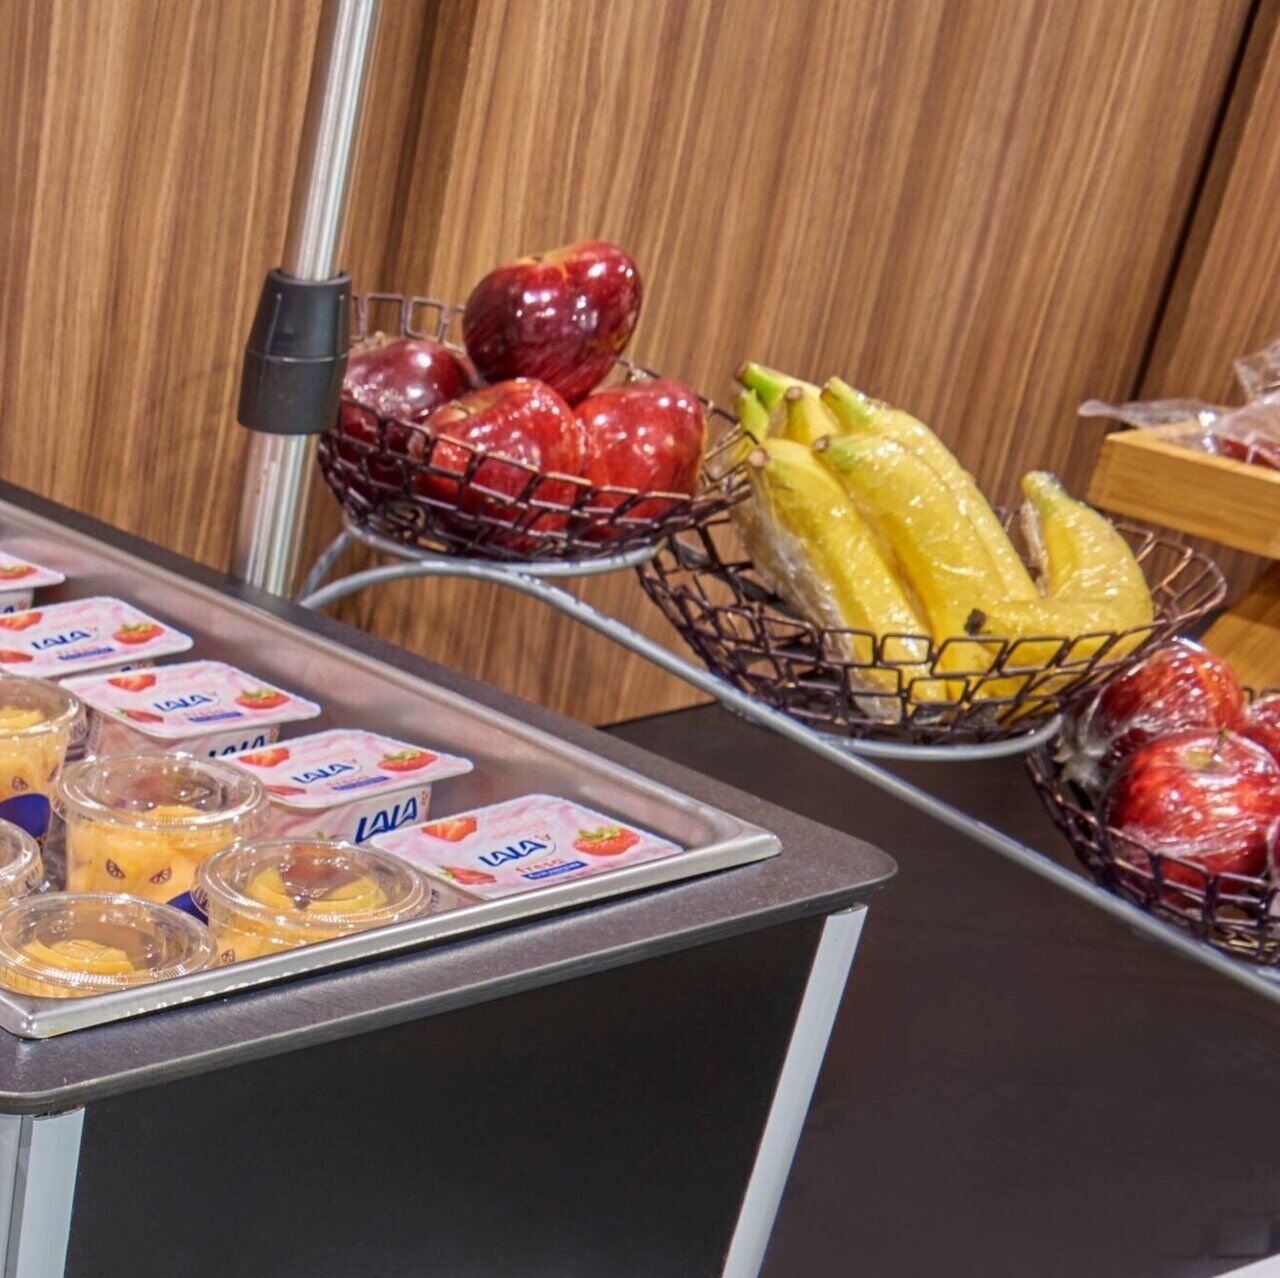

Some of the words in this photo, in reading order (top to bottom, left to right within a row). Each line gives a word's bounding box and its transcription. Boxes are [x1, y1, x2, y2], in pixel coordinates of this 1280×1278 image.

[31, 630, 91, 650] LALA
[154, 694, 213, 712] LALA
[291, 763, 354, 784] LALA
[355, 797, 418, 844] LALA
[479, 839, 548, 867] LALA
